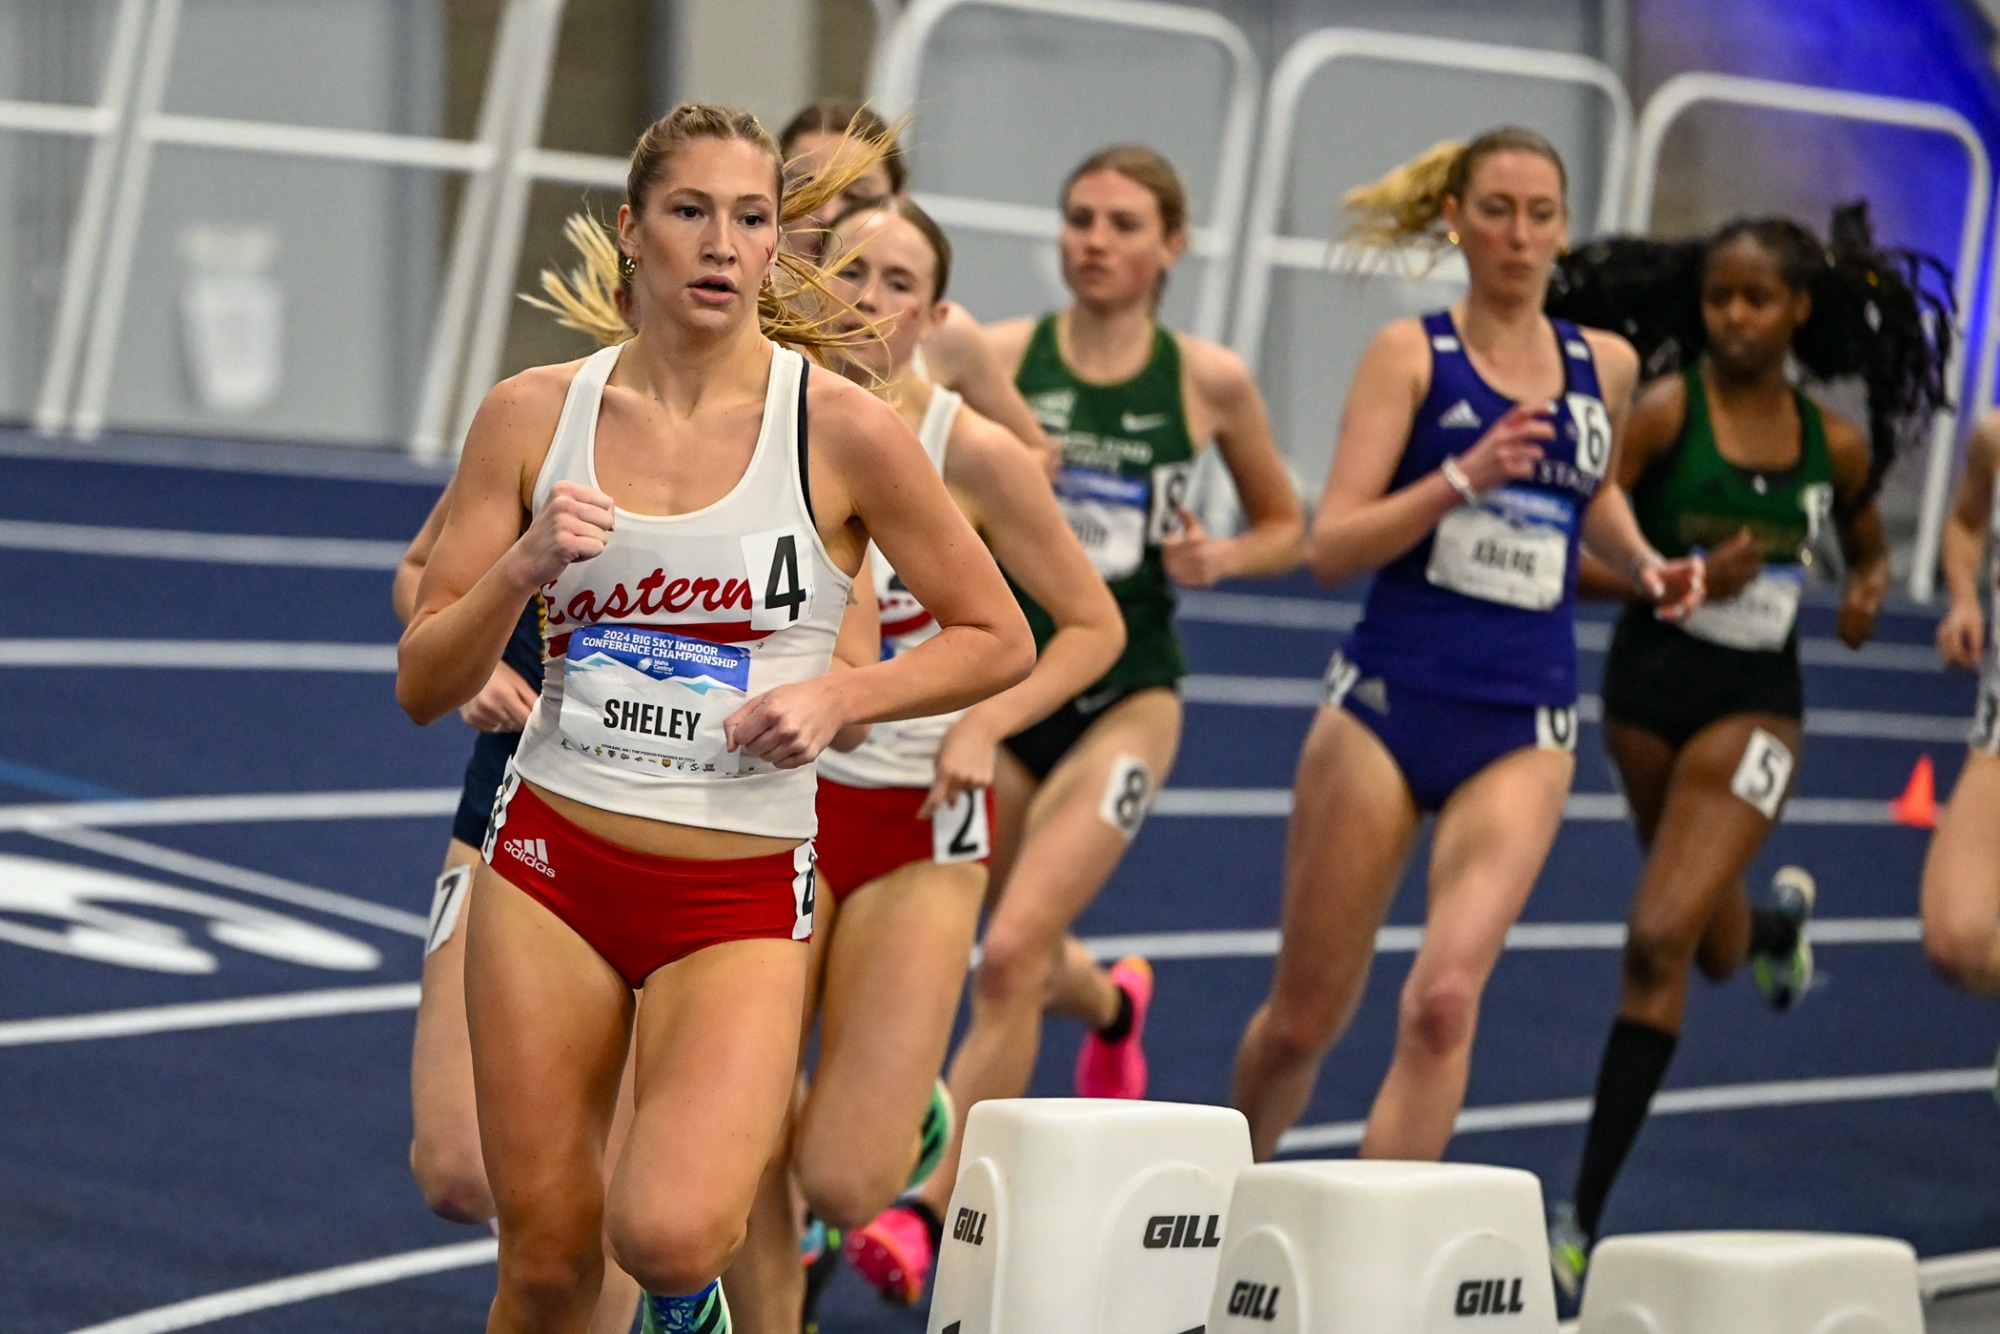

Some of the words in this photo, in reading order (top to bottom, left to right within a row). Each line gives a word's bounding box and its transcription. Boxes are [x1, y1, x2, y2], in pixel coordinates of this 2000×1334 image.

[541, 568, 753, 625] Eastern
[764, 534, 807, 622] 4
[582, 637, 651, 655] CONFERENCE
[652, 647, 739, 669] CHAMPIONSHIP
[603, 629, 631, 642] 2024
[632, 634, 651, 645] BIG
[652, 637, 675, 649] SKY
[675, 642, 719, 656] INDOOR
[602, 698, 702, 741] SHELEY
[1748, 747, 1781, 798] 5
[1115, 766, 1149, 830] 8
[947, 790, 979, 856] 2
[503, 839, 556, 879] adidas
[431, 871, 462, 943] 7
[953, 1206, 987, 1246] GILL
[1143, 1214, 1221, 1249] GILL
[1228, 1279, 1281, 1322] GILL
[1454, 1277, 1525, 1318] GILL
